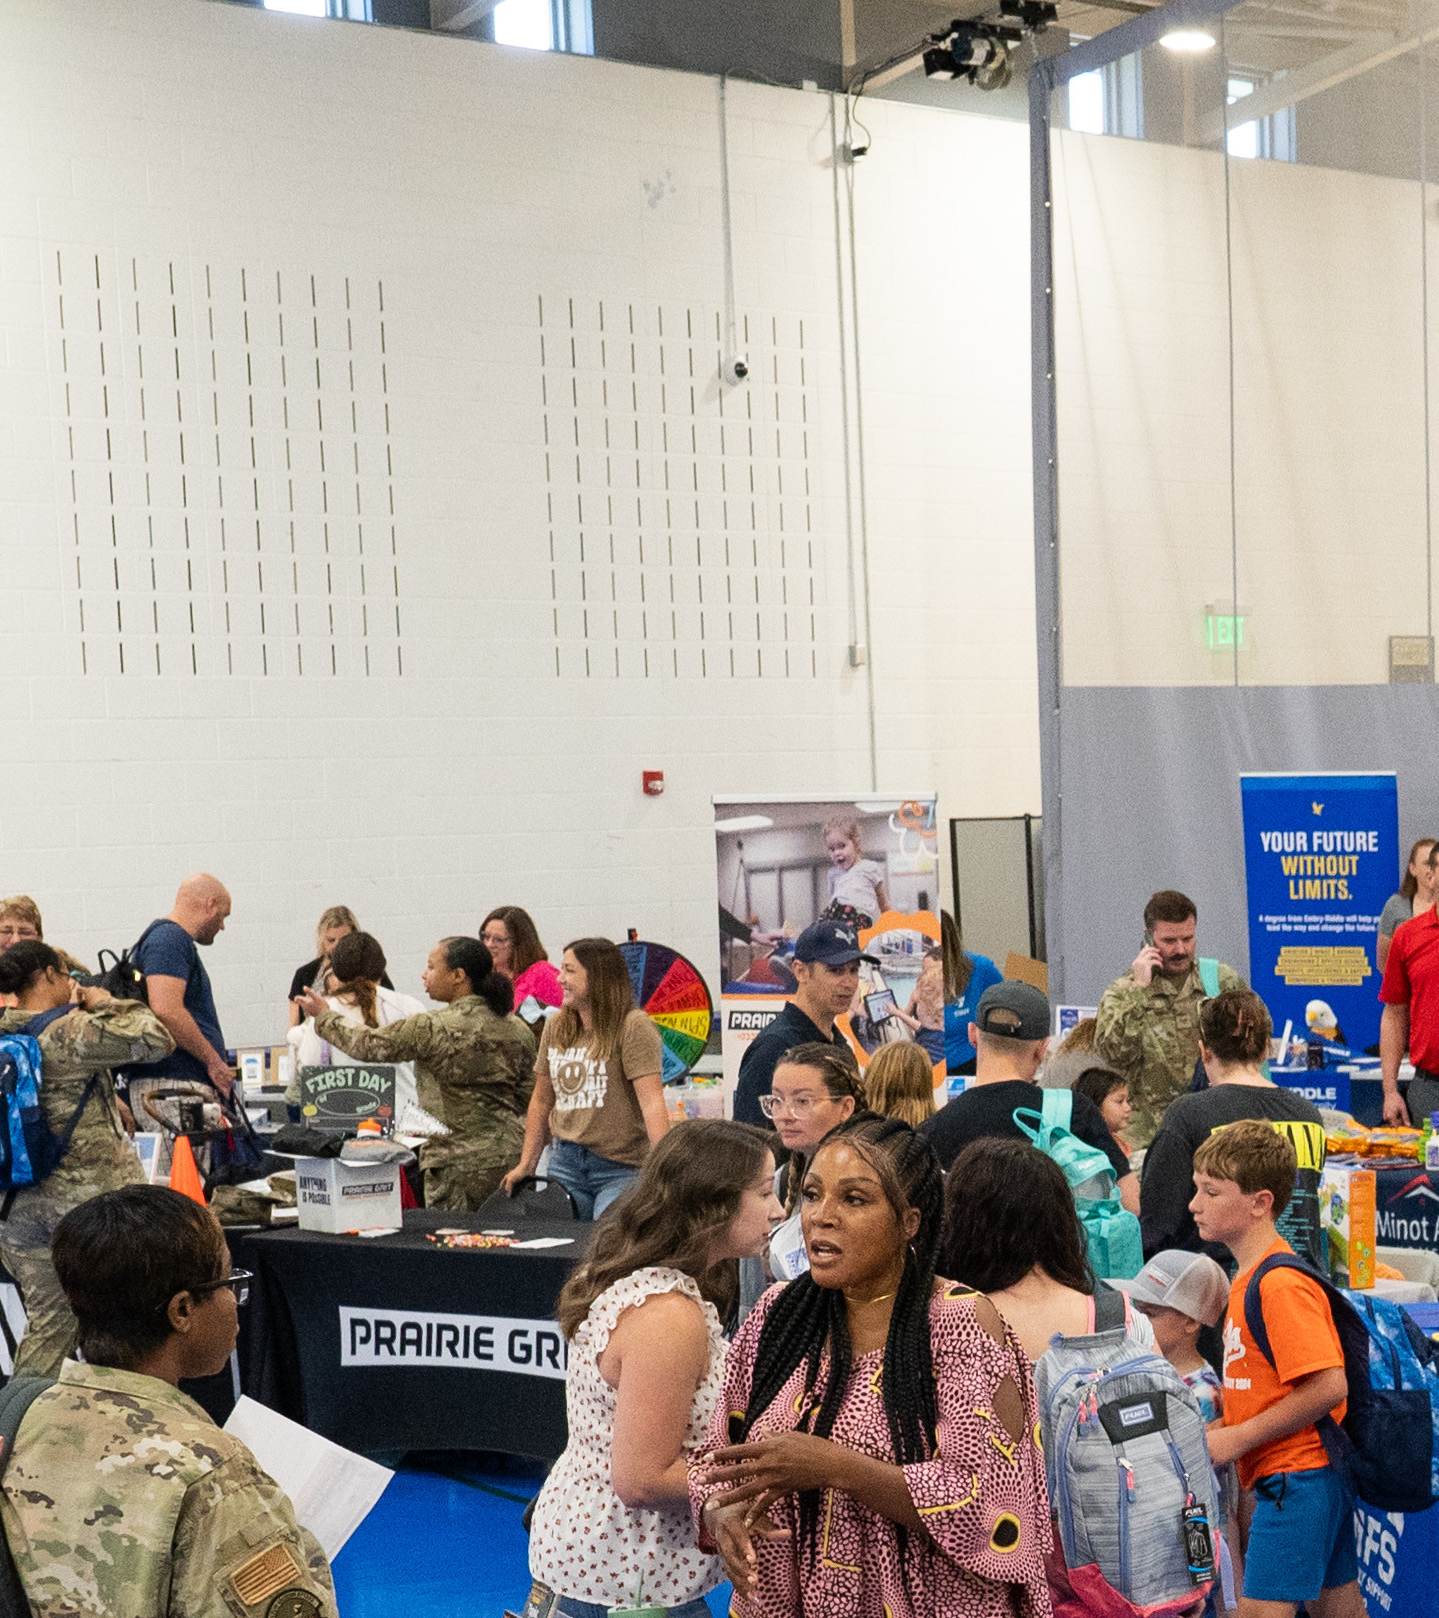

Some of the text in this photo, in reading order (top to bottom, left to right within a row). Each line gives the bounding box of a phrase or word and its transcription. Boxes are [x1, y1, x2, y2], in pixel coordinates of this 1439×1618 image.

[1260, 831, 1378, 852] YOUR FUTURE
[1281, 855, 1359, 876] WITHOUT
[1289, 879, 1353, 900] LIMITS.
[305, 1068, 392, 1093] FIRST DAY
[299, 1176, 327, 1192] ANYTHING
[1376, 1211, 1429, 1240] Minot
[349, 1317, 495, 1361] PRAIRIE
[1125, 1405, 1151, 1421] FUEL
